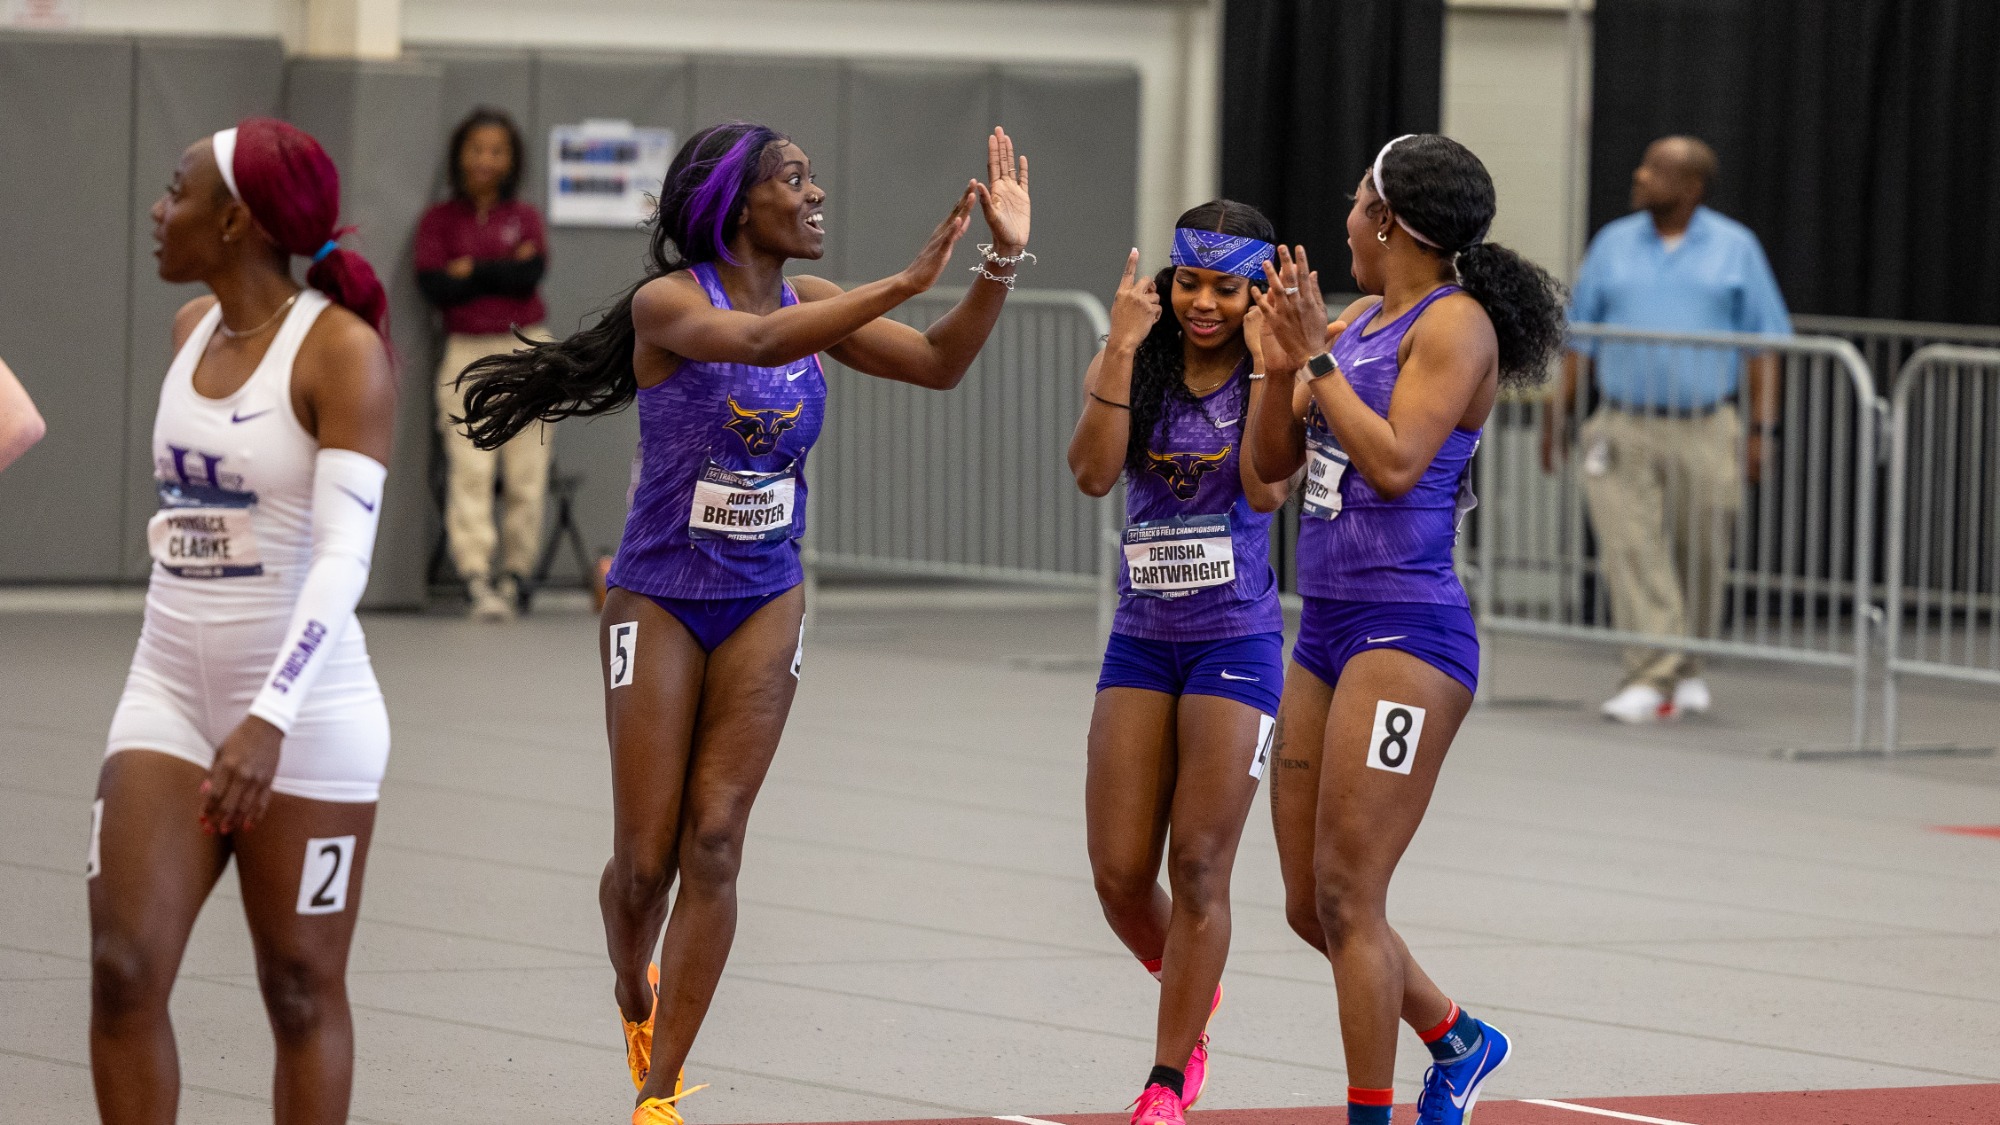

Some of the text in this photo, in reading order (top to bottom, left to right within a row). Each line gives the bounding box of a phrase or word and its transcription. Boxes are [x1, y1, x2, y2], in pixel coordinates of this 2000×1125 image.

[726, 489, 774, 505] ADEYAH
[703, 503, 784, 526] BREWSTER
[1139, 529, 1156, 538] TRACK
[1160, 528, 1175, 536] FIELD
[1176, 525, 1226, 535] CHAMPIONSHIPS
[169, 537, 230, 560] CLARKE
[1149, 543, 1205, 561] DENISHA
[1132, 560, 1230, 584] CARTWRIGHT
[615, 626, 631, 684] 5
[1379, 707, 1413, 768] 8
[310, 843, 342, 907] 2
